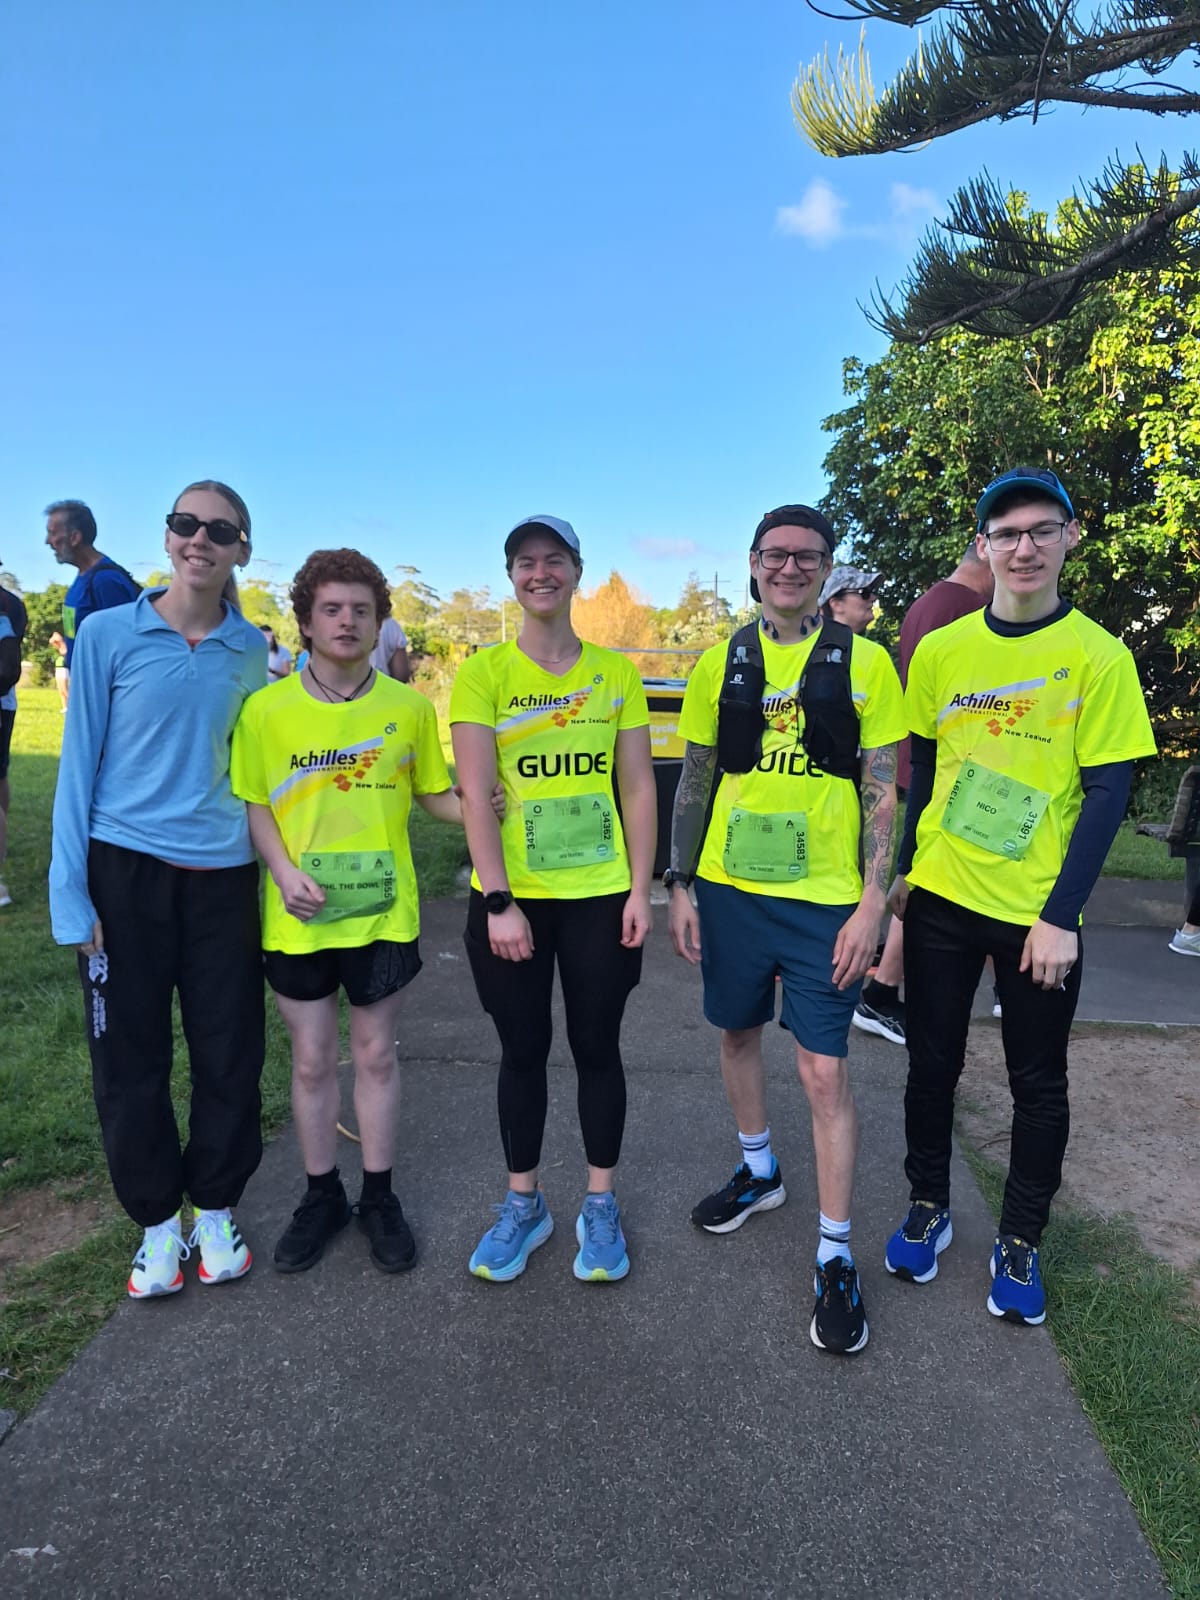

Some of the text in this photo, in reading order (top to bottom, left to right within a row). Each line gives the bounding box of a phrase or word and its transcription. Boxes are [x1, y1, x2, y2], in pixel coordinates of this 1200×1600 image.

[508, 693, 570, 708] Achilles
[760, 697, 795, 713] illes
[950, 693, 1012, 712] Achilles
[1005, 728, 1021, 737] New
[290, 749, 357, 770] Achilles
[517, 752, 607, 778] GUIDE
[756, 752, 823, 778] UIDE
[976, 801, 997, 815] NICO
[525, 819, 535, 850] 34362
[602, 811, 611, 840] 34362
[1018, 811, 1038, 840] 31391
[796, 831, 805, 861] 34583
[340, 882, 355, 890] THE
